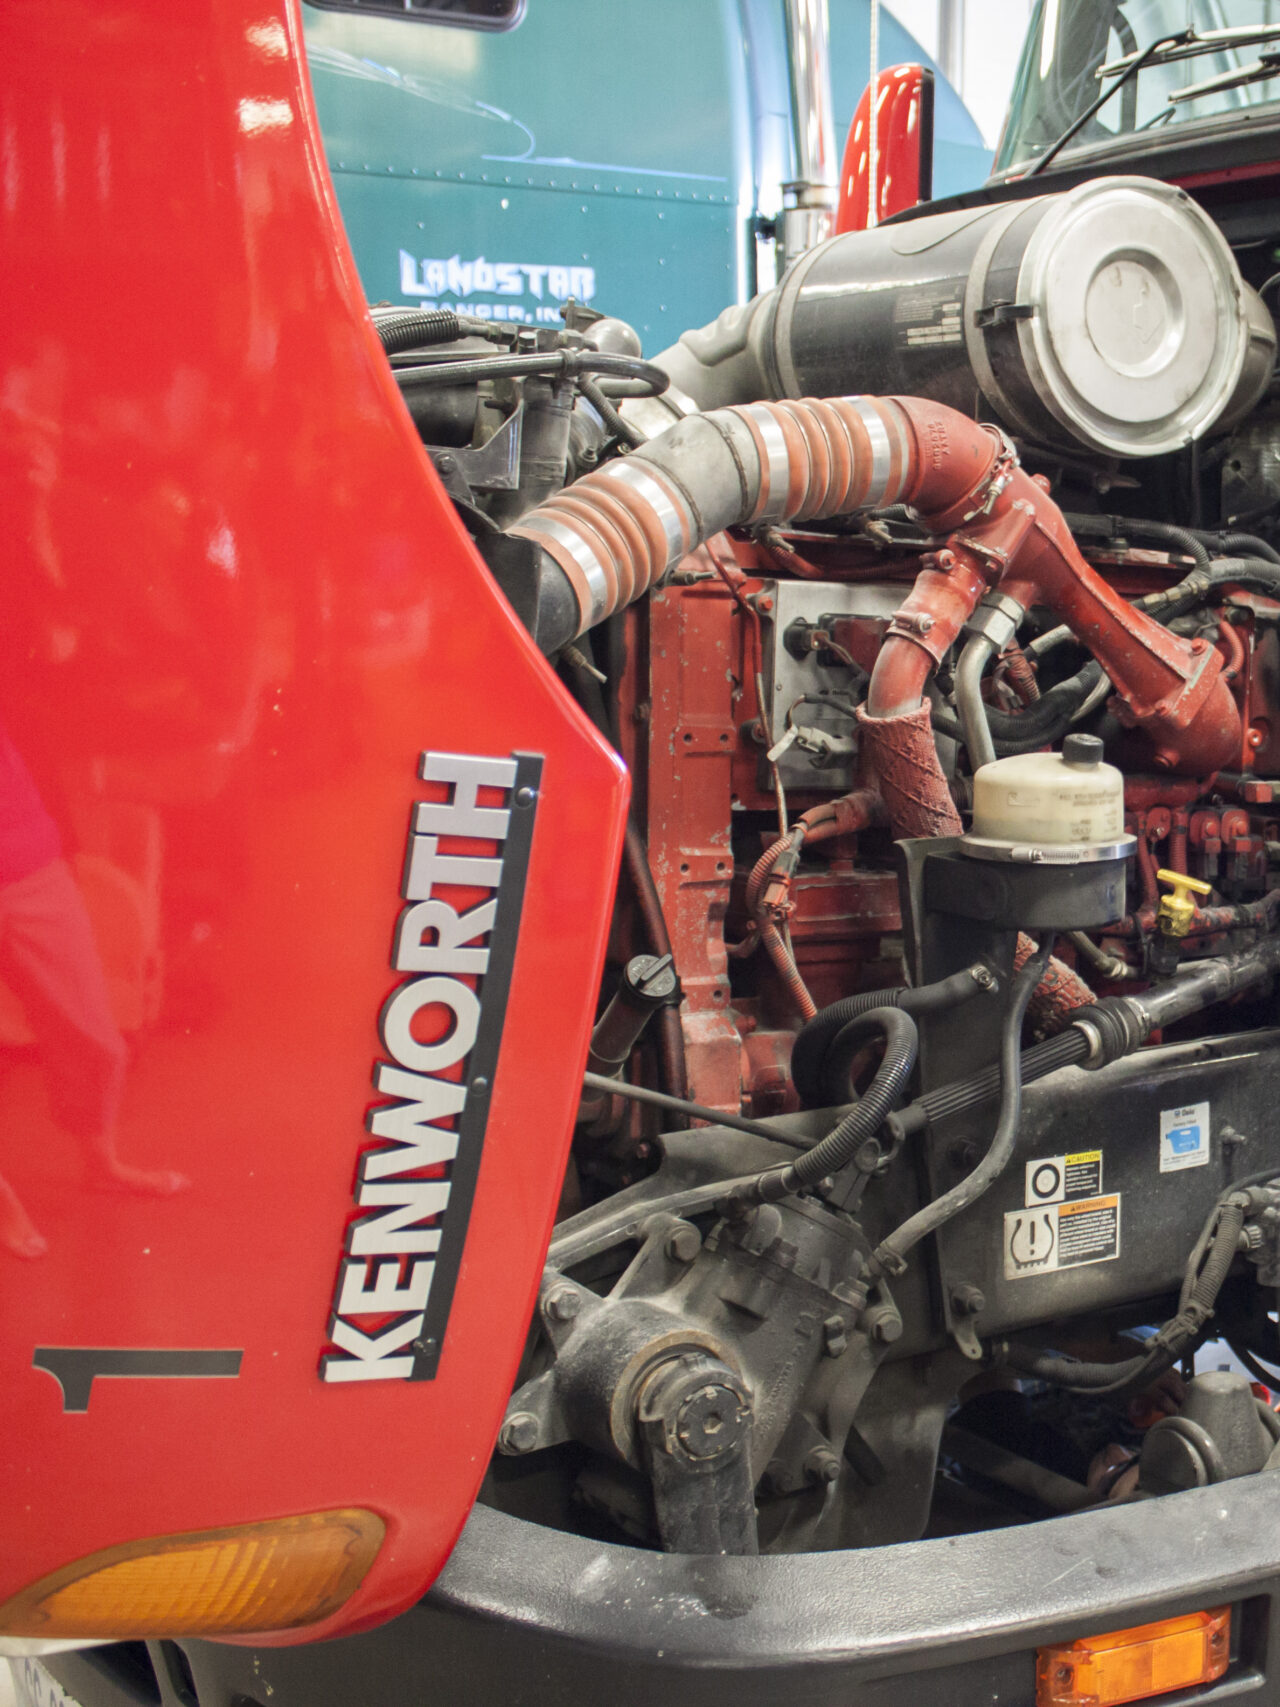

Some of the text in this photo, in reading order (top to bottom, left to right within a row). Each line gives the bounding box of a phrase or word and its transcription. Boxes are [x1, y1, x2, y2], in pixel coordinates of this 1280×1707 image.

[400, 249, 595, 301] LANDSTAR
[321, 751, 517, 1382] KENWORTH
[1072, 1152, 1100, 1161] CAUTION
[1076, 1200, 1106, 1209] WARNING
[32, 1345, 245, 1413] 1
